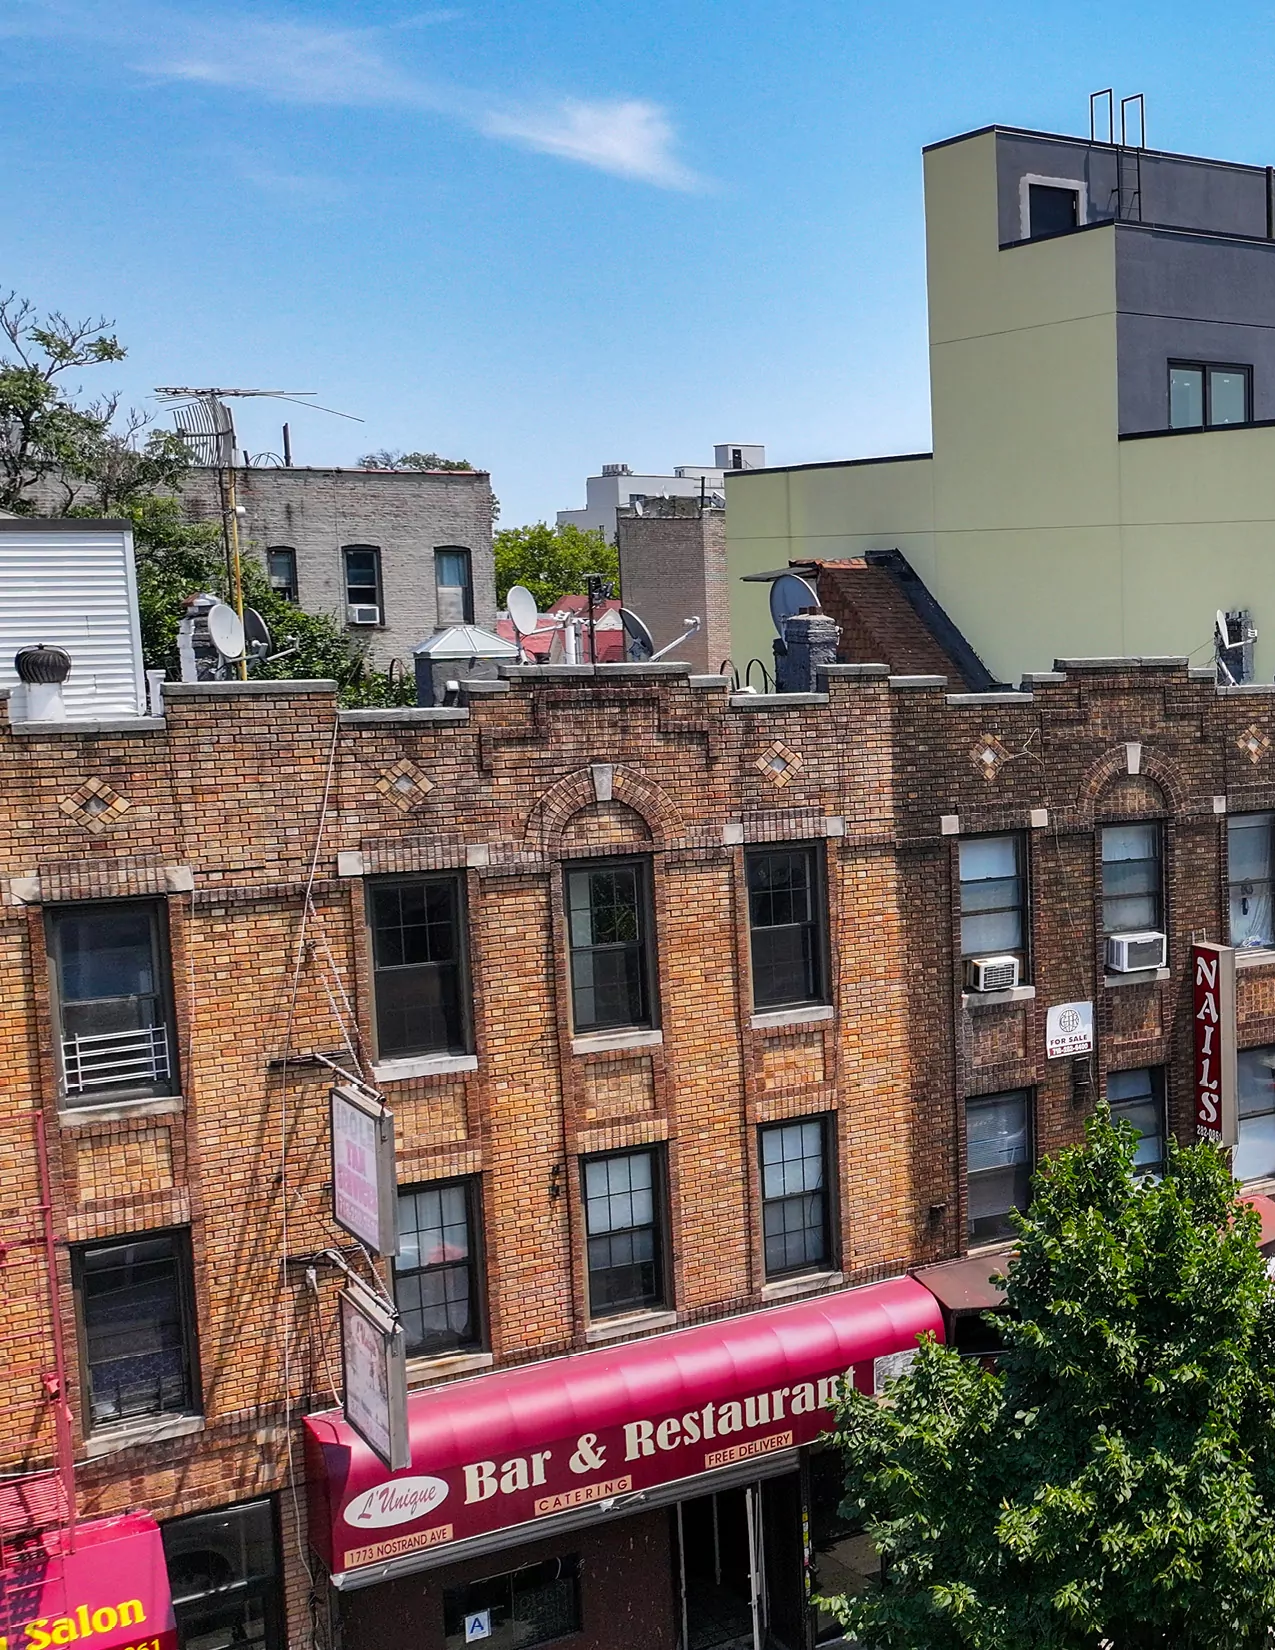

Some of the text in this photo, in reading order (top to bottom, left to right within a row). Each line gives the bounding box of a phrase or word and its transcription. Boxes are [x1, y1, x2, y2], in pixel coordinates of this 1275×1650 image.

[1050, 1034, 1088, 1046] FOR SALE
[1196, 956, 1219, 1123] NAILS
[462, 1365, 857, 1505] Bar & Restaurant
[707, 1432, 791, 1466] FREE DELIVERY
[357, 1484, 438, 1521] L'Unique
[538, 1478, 629, 1512] CATERING
[350, 1528, 448, 1564] 1773 NOSTRAND AVE
[24, 1598, 147, 1650] Salon
[469, 1616, 485, 1634] A
